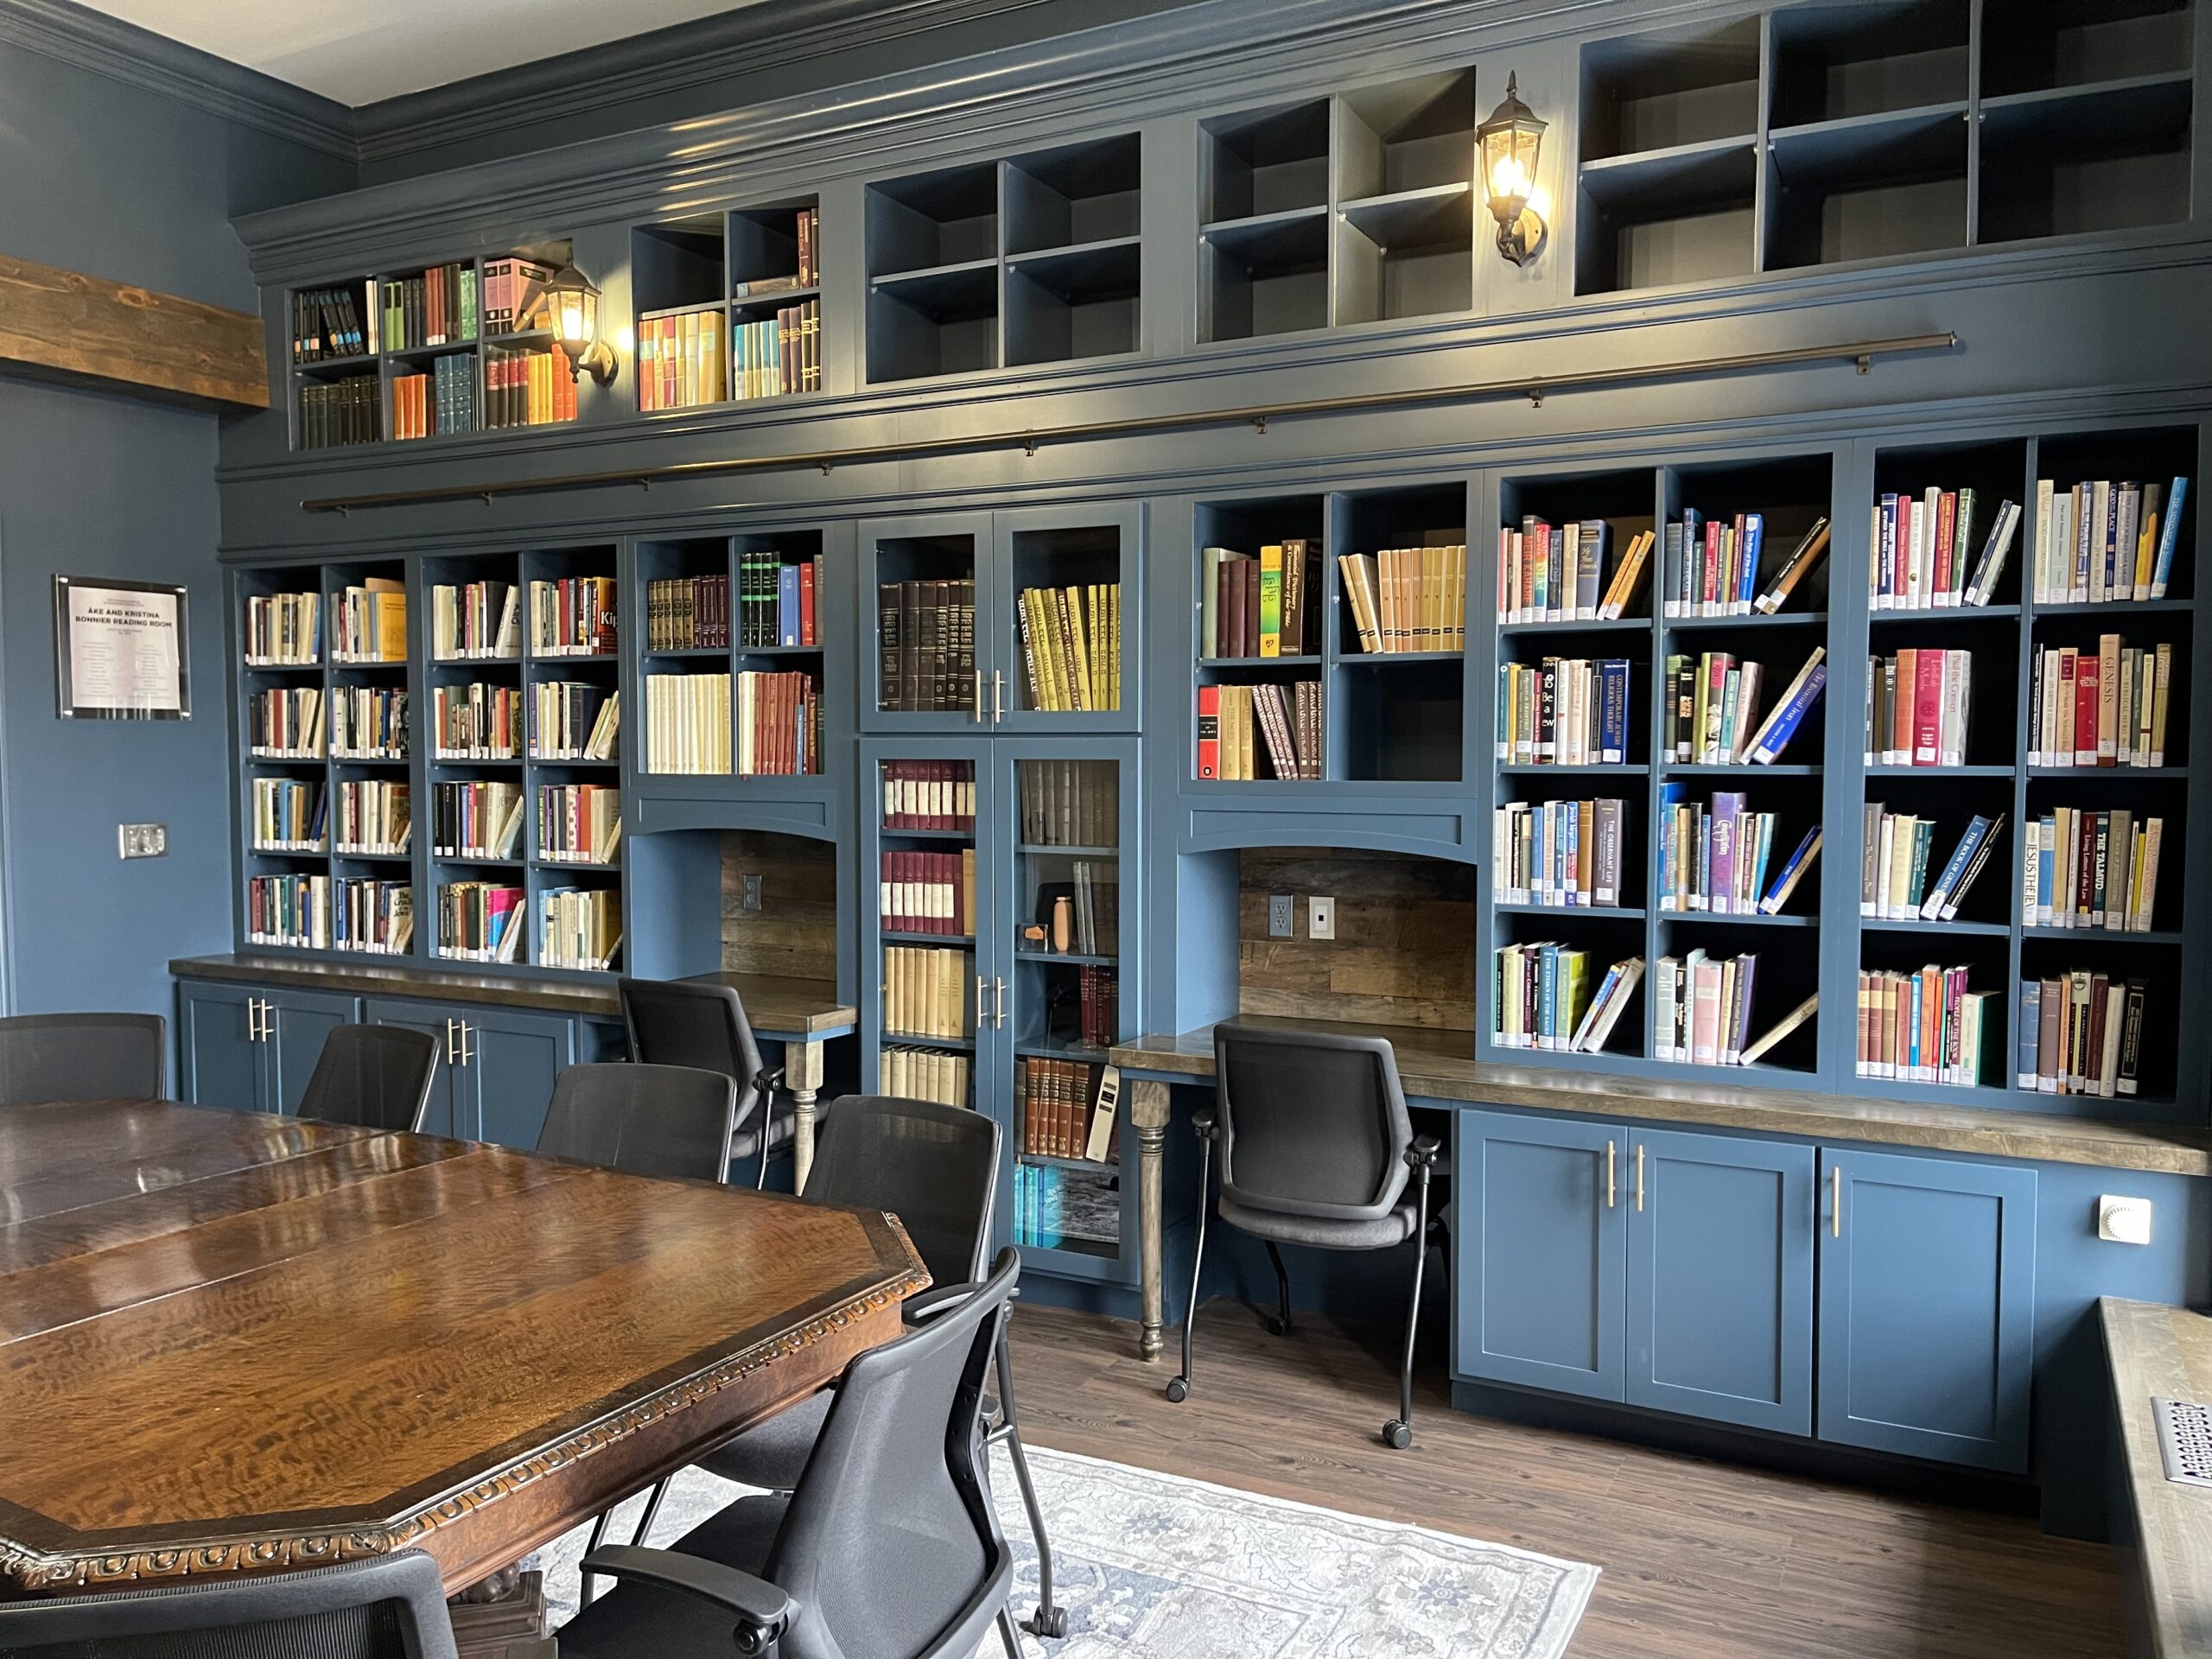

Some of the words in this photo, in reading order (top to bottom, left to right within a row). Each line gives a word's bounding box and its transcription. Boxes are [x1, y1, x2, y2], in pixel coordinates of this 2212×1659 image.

[1523, 535, 1532, 559] MEIR
[1523, 564, 1532, 603] KAHANE
[75, 615, 111, 624] BONNIER
[112, 618, 148, 626] READING
[124, 610, 160, 619] KRISTINA
[1069, 601, 1077, 626] תלמוד
[1018, 599, 1027, 622] תלמוד
[1026, 649, 1035, 674] עבודה
[1951, 655, 1961, 670] Paul
[1813, 672, 1824, 683] The
[1951, 671, 1961, 683] the
[2103, 657, 2115, 703] GENESIS
[1542, 692, 1554, 702] Be
[1606, 675, 1615, 705] RELIGIOUS
[1614, 675, 1624, 722] CONTEMPORARY
[1796, 683, 1819, 708] Historical
[1949, 683, 1960, 713] Convert
[1785, 707, 1803, 721] Jesus
[1568, 806, 1577, 823] Jewish
[1966, 832, 1978, 845] THE
[2082, 835, 2091, 852] Living
[2096, 832, 2107, 850] THE
[1605, 833, 1615, 869] OBSERVANT
[1956, 845, 1970, 864] BOOK
[2026, 843, 2037, 873] JESUS
[1951, 862, 1959, 873] OF
[2082, 853, 2090, 873] Letters
[2095, 853, 2105, 891] TALMUD
[2025, 874, 2036, 893] THE
